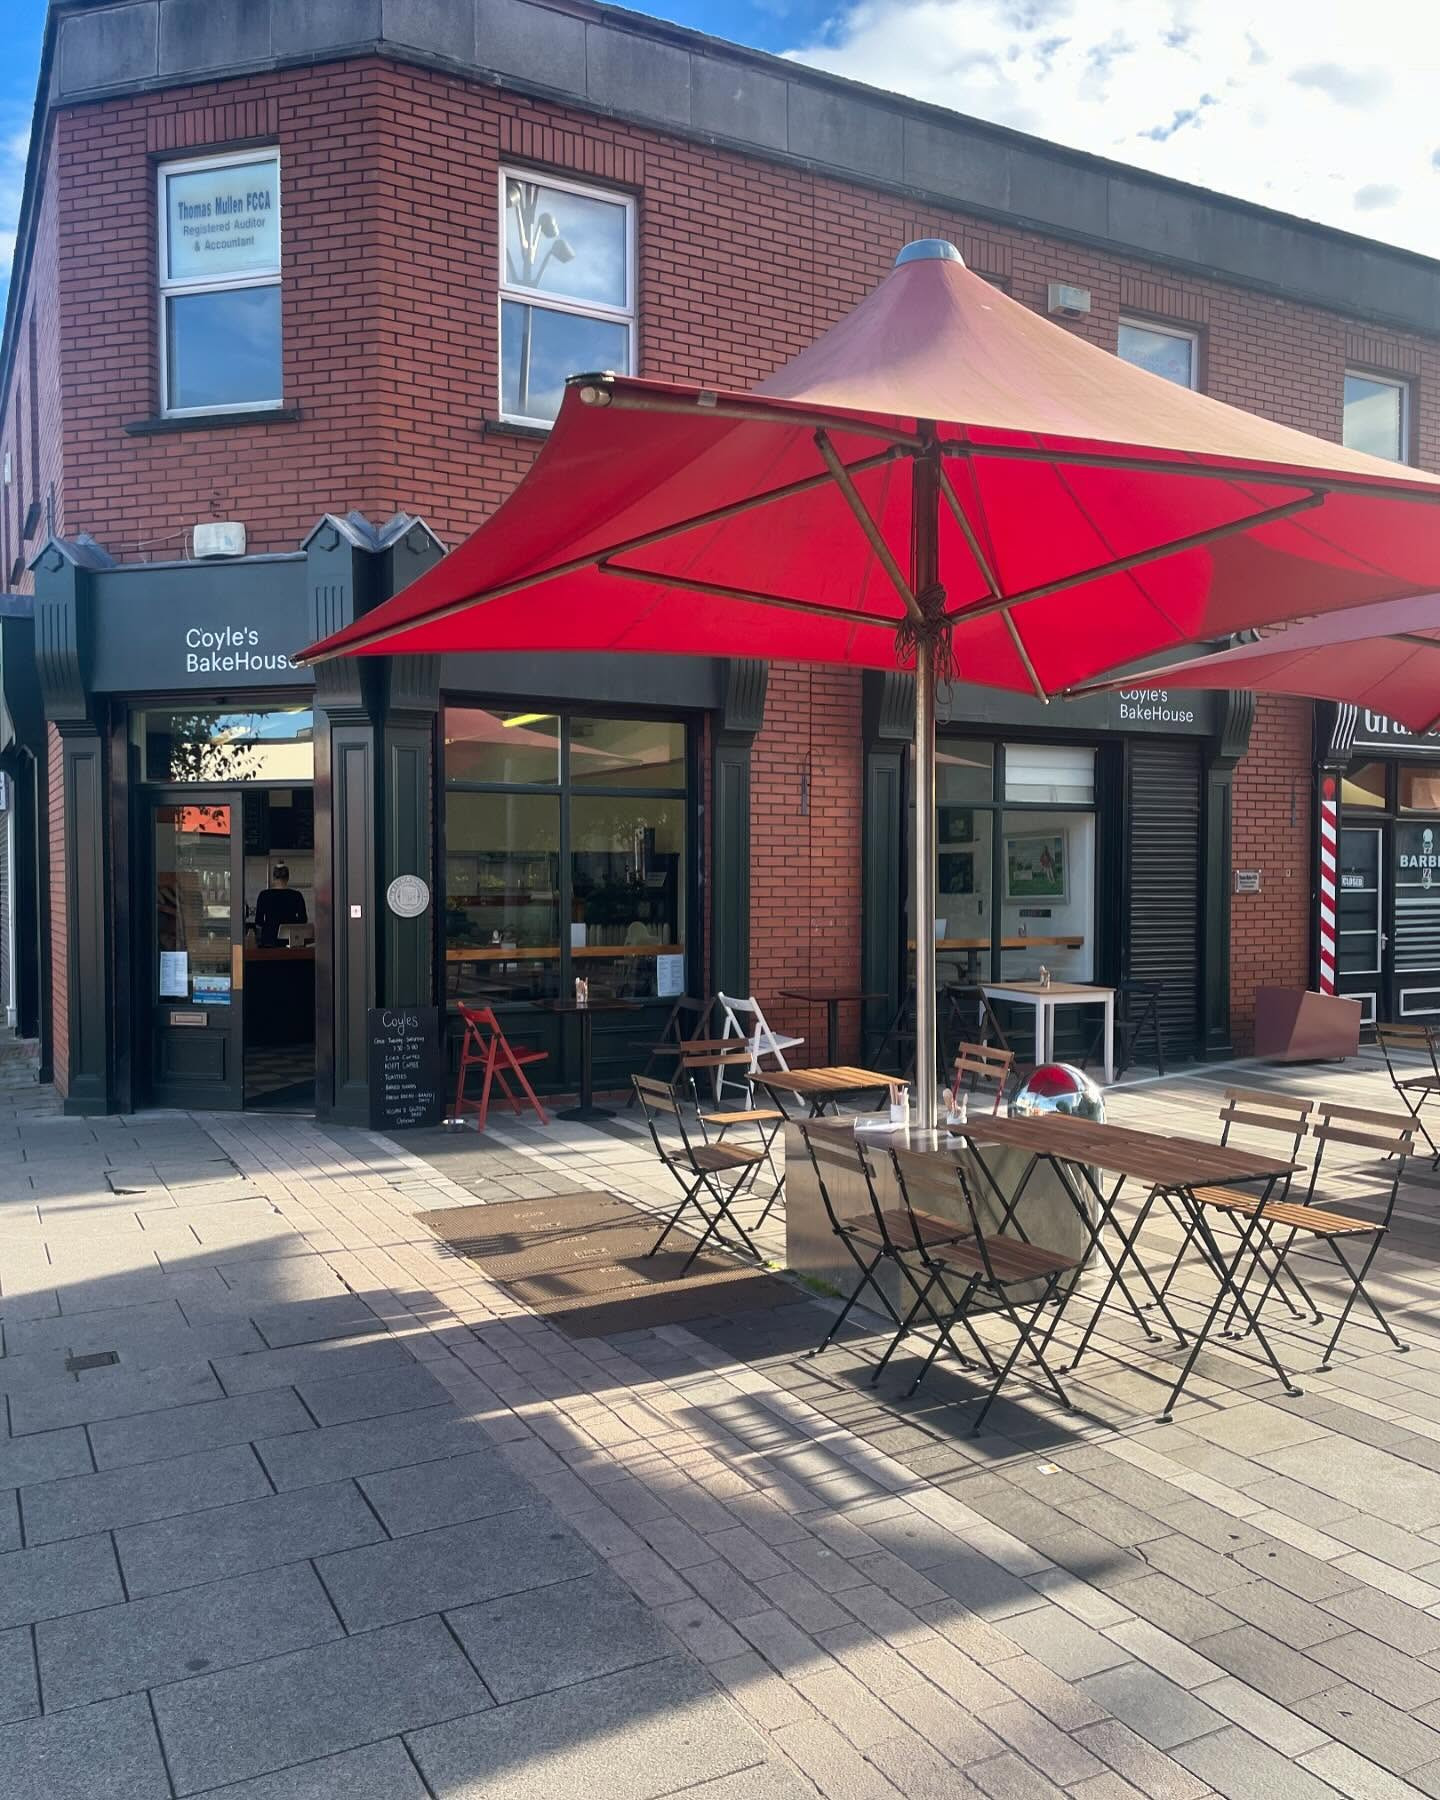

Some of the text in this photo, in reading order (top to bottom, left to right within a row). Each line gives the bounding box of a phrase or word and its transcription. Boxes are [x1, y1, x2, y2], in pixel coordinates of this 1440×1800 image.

[178, 191, 271, 220] Thomas Mullen FCCA
[183, 218, 265, 236] Registered Auditor
[194, 236, 254, 252] & Accountant
[186, 626, 259, 651] Coyle's
[1120, 689, 1168, 704] Coyle's
[1120, 704, 1194, 722] BakeHouse
[382, 1010, 419, 1036] Coyles
